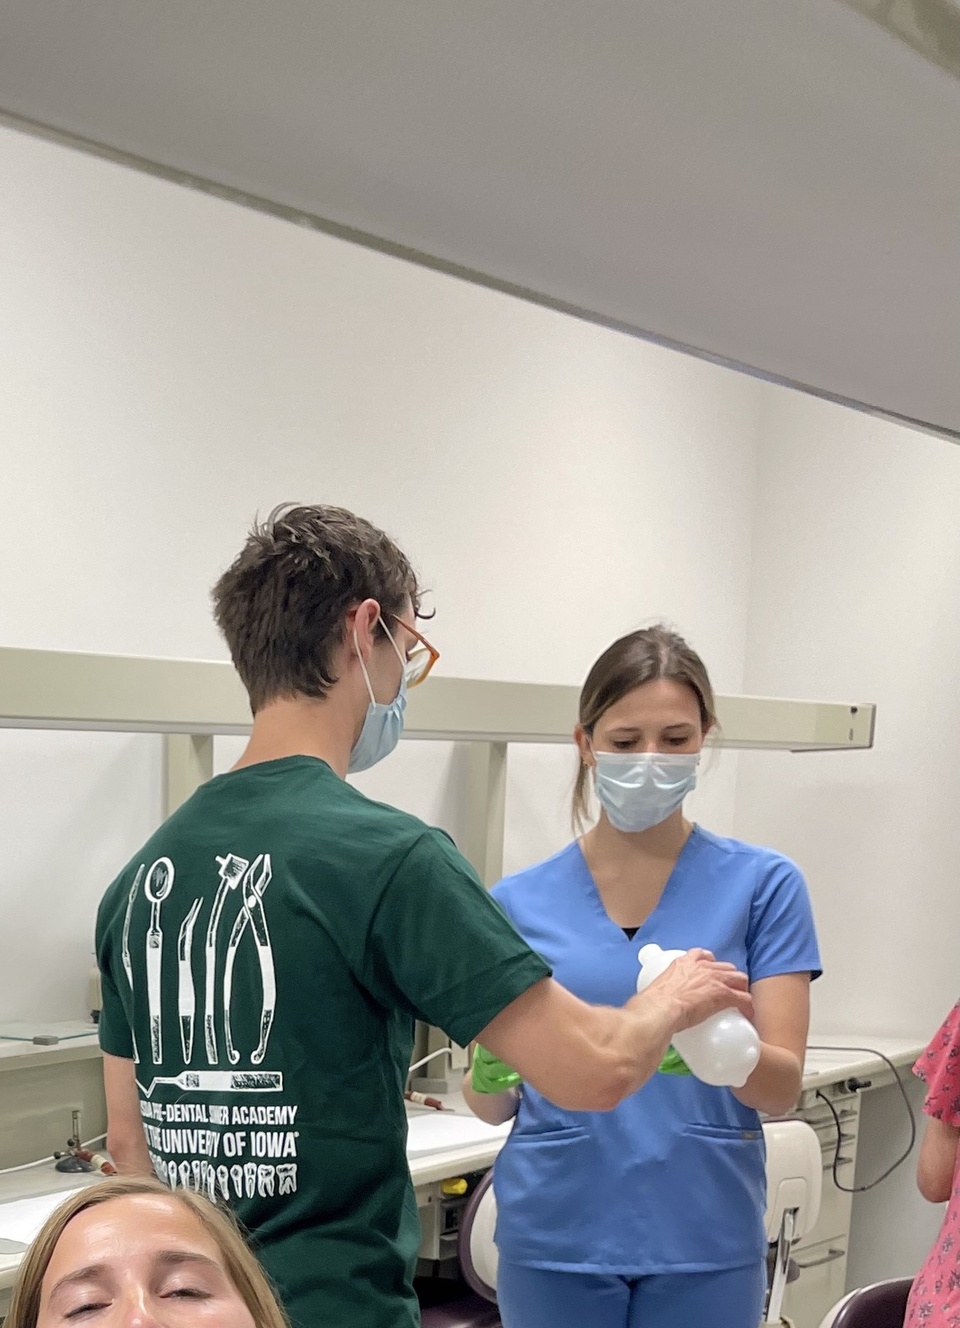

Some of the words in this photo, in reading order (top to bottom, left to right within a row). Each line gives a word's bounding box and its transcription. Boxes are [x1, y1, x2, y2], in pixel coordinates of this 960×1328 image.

[231, 1105, 298, 1126] ACADEMY
[223, 1131, 246, 1158] OF
[250, 1131, 298, 1158] IOWA
